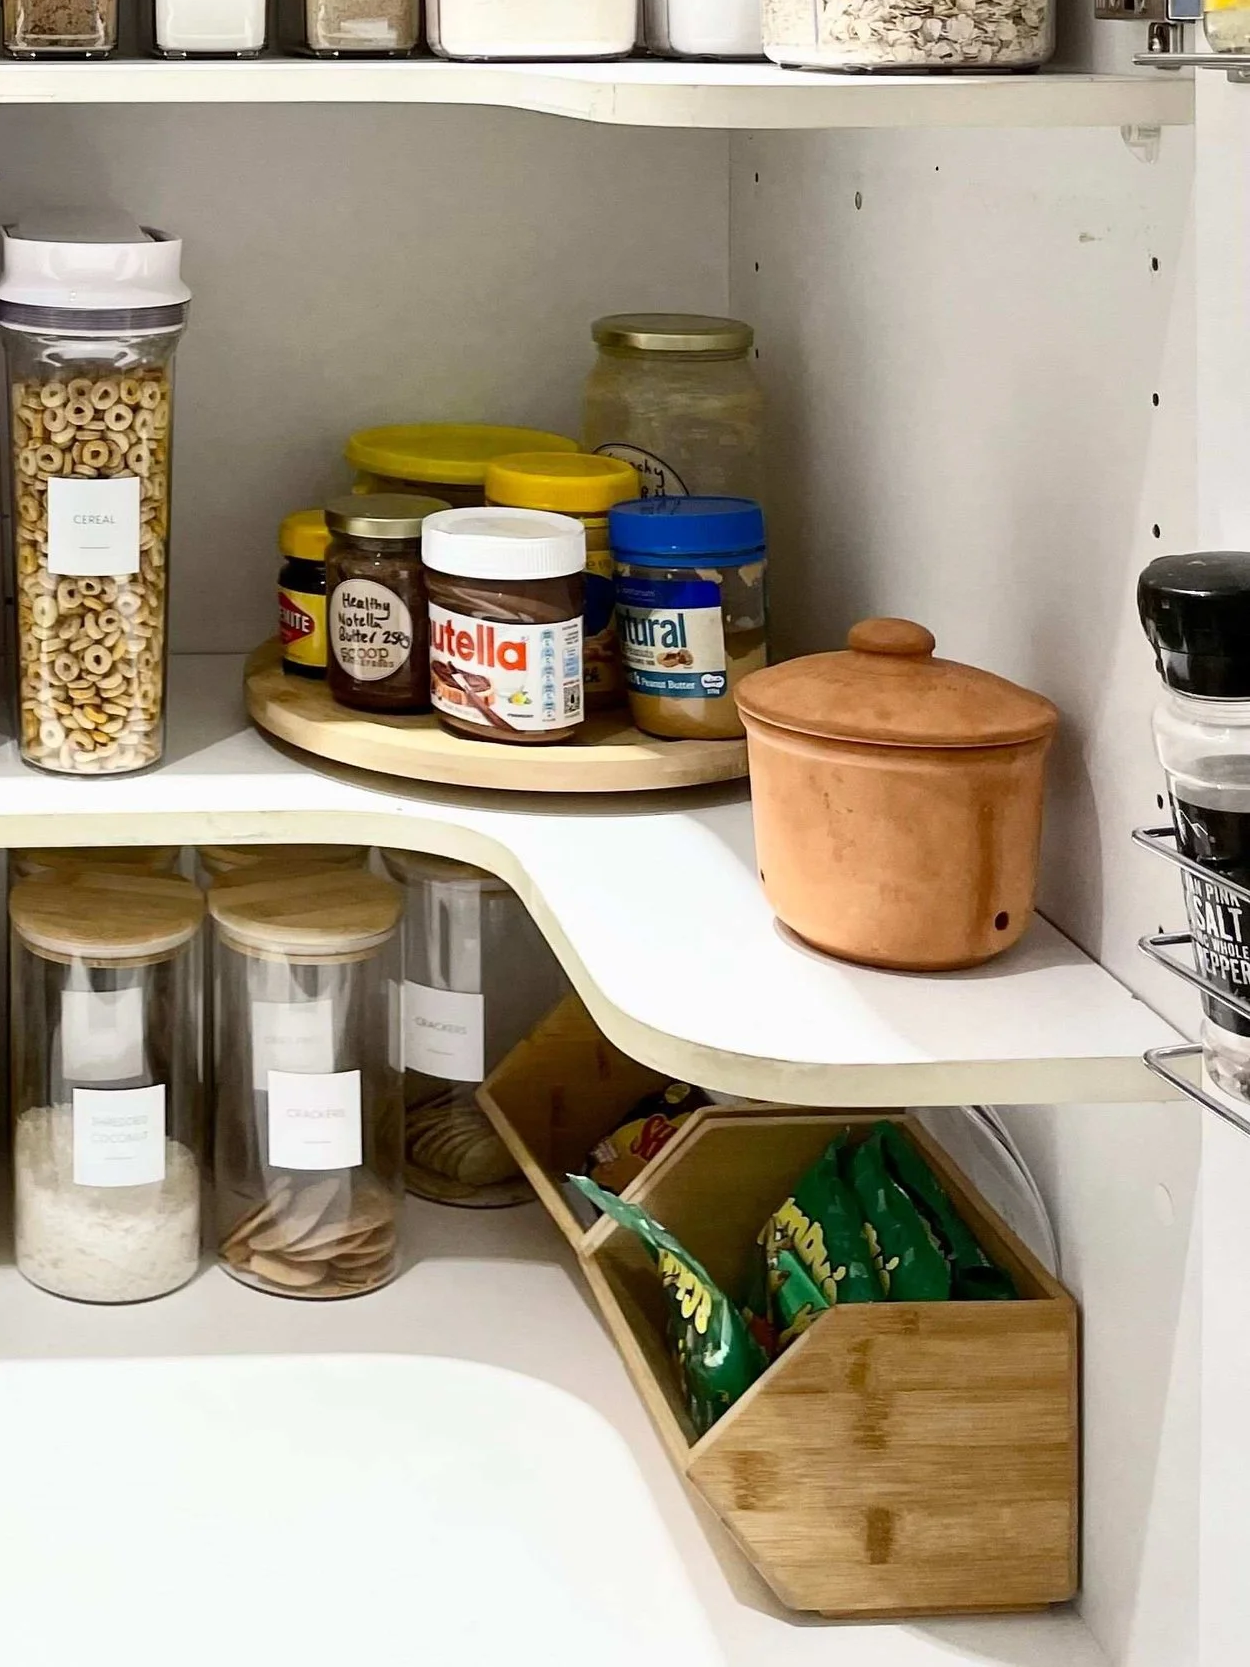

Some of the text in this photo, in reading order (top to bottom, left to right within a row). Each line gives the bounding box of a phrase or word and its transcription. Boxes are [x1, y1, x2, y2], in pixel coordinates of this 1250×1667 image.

[73, 514, 115, 525] CEREAL
[342, 592, 391, 620] Healthy
[338, 612, 382, 629] Notella
[338, 626, 377, 643] Butter
[340, 647, 389, 659] SCOOP
[641, 677, 696, 690] Peanut Butter
[1193, 895, 1243, 943] SALT
[1211, 939, 1250, 960] WHOLE
[413, 1015, 468, 1036] CRACKERS
[286, 1107, 347, 1119] CRACKERS
